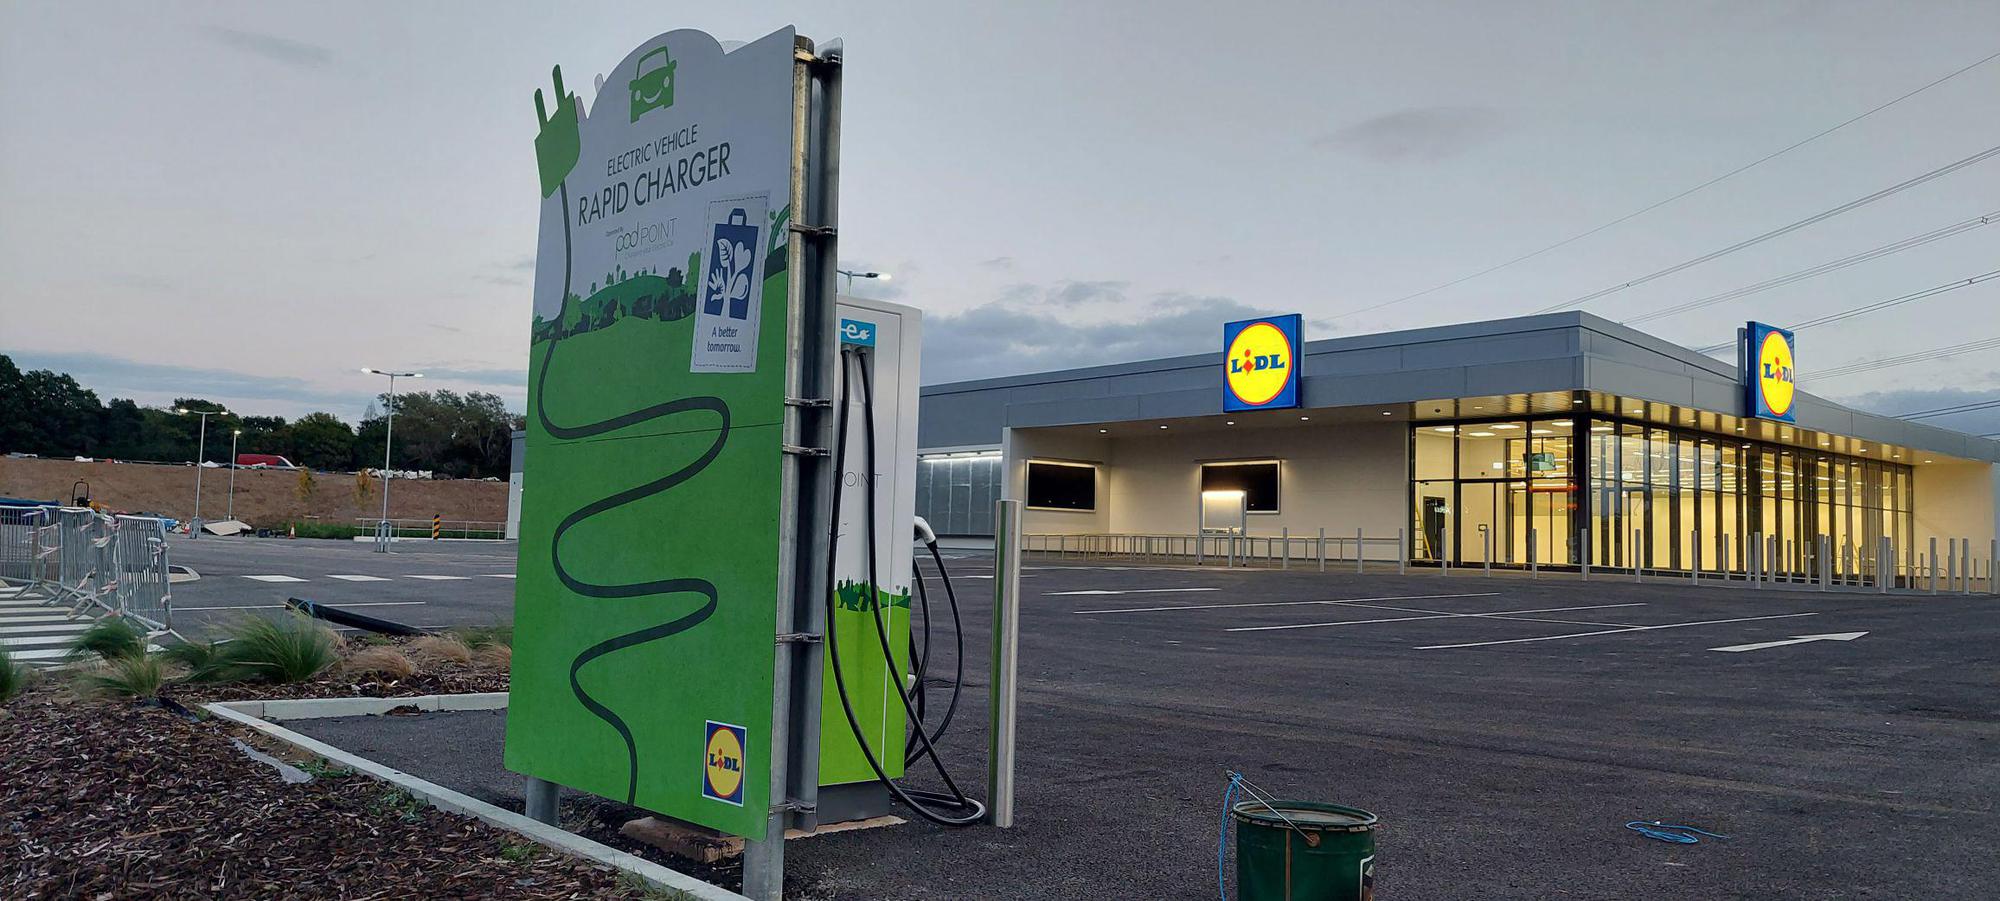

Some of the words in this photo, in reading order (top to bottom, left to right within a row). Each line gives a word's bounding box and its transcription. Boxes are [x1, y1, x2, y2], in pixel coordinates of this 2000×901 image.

[607, 143, 651, 177] ELECTRIC
[654, 124, 698, 157] VEHICLE
[578, 181, 629, 227] RAPID
[634, 142, 731, 206] CHARGER
[640, 217, 678, 246] POINT
[711, 326, 717, 338] A
[718, 326, 738, 338] better
